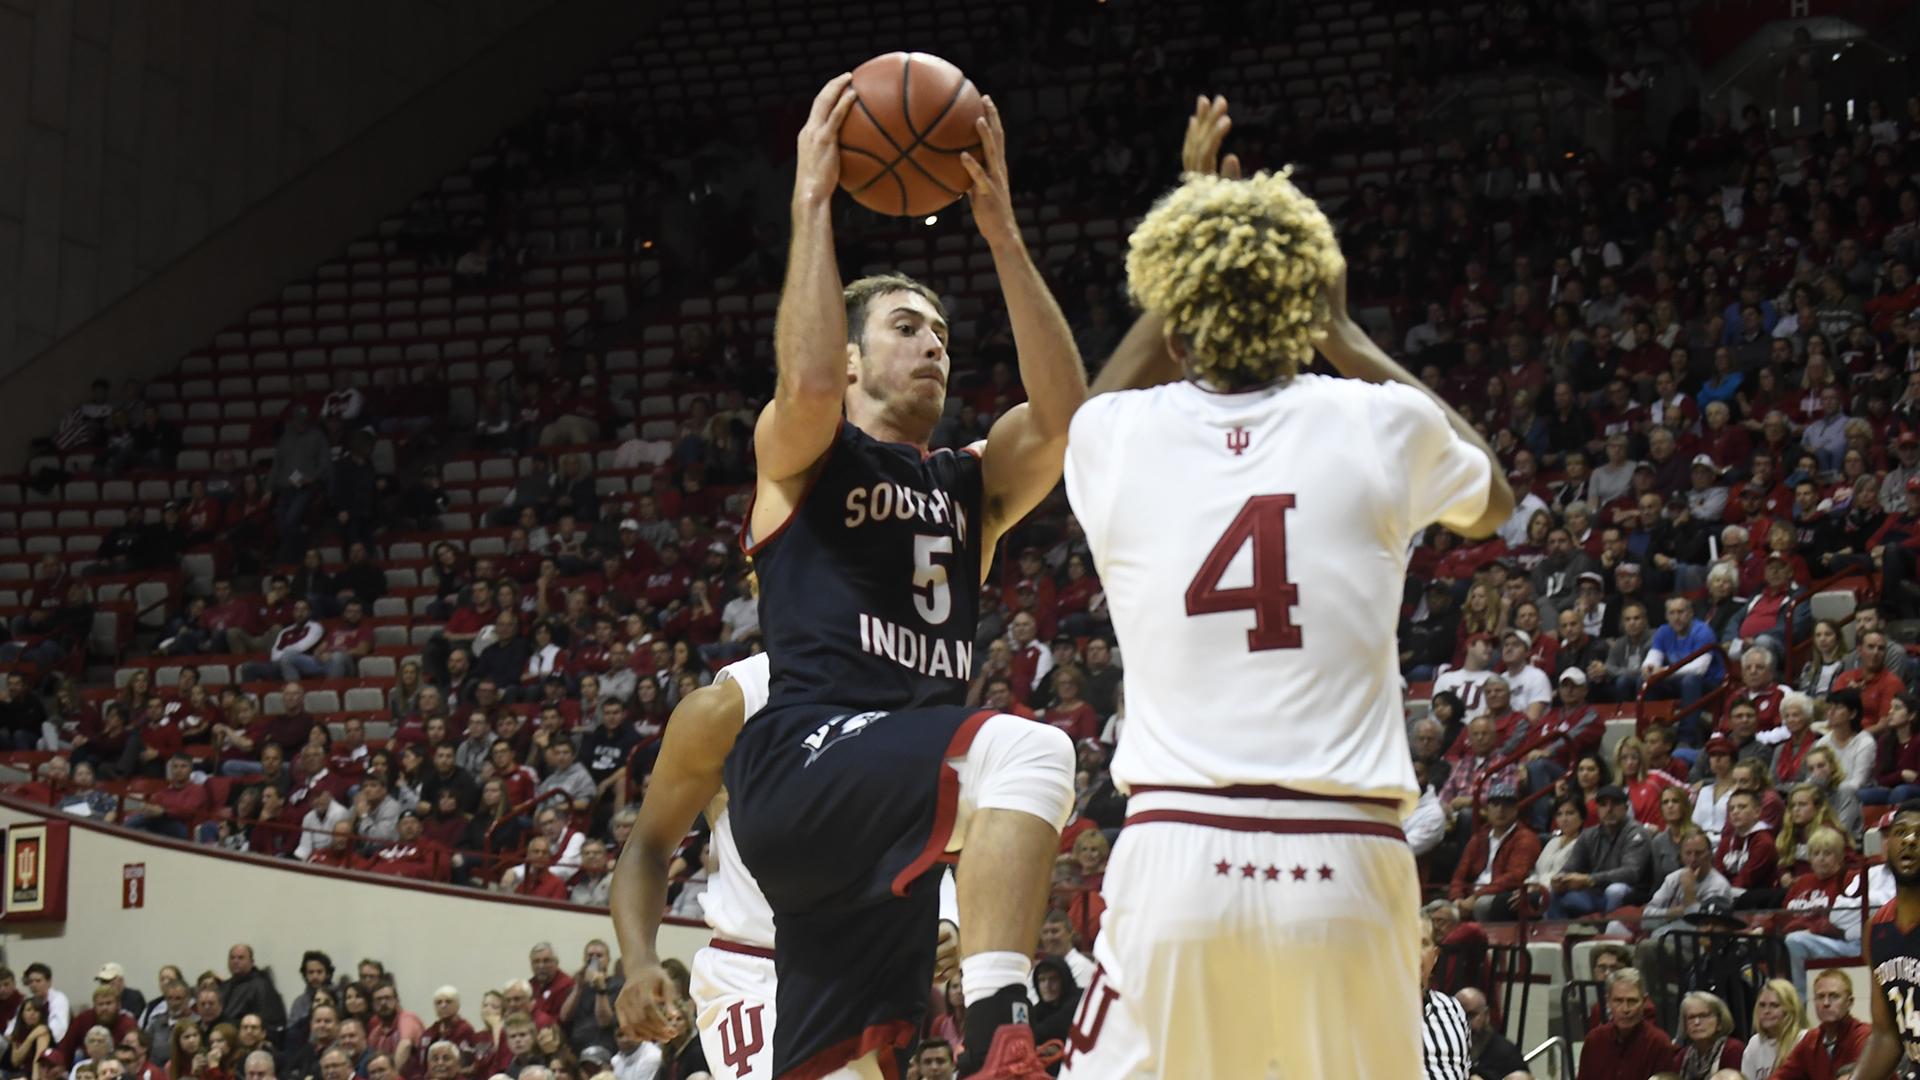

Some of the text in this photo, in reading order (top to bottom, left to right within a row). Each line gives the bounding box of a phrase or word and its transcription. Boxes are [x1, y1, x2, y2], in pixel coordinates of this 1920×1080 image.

[844, 482, 968, 550] SOUTHN
[911, 534, 953, 625] 5
[1185, 493, 1303, 652] 4
[859, 612, 973, 682] INDIAN
